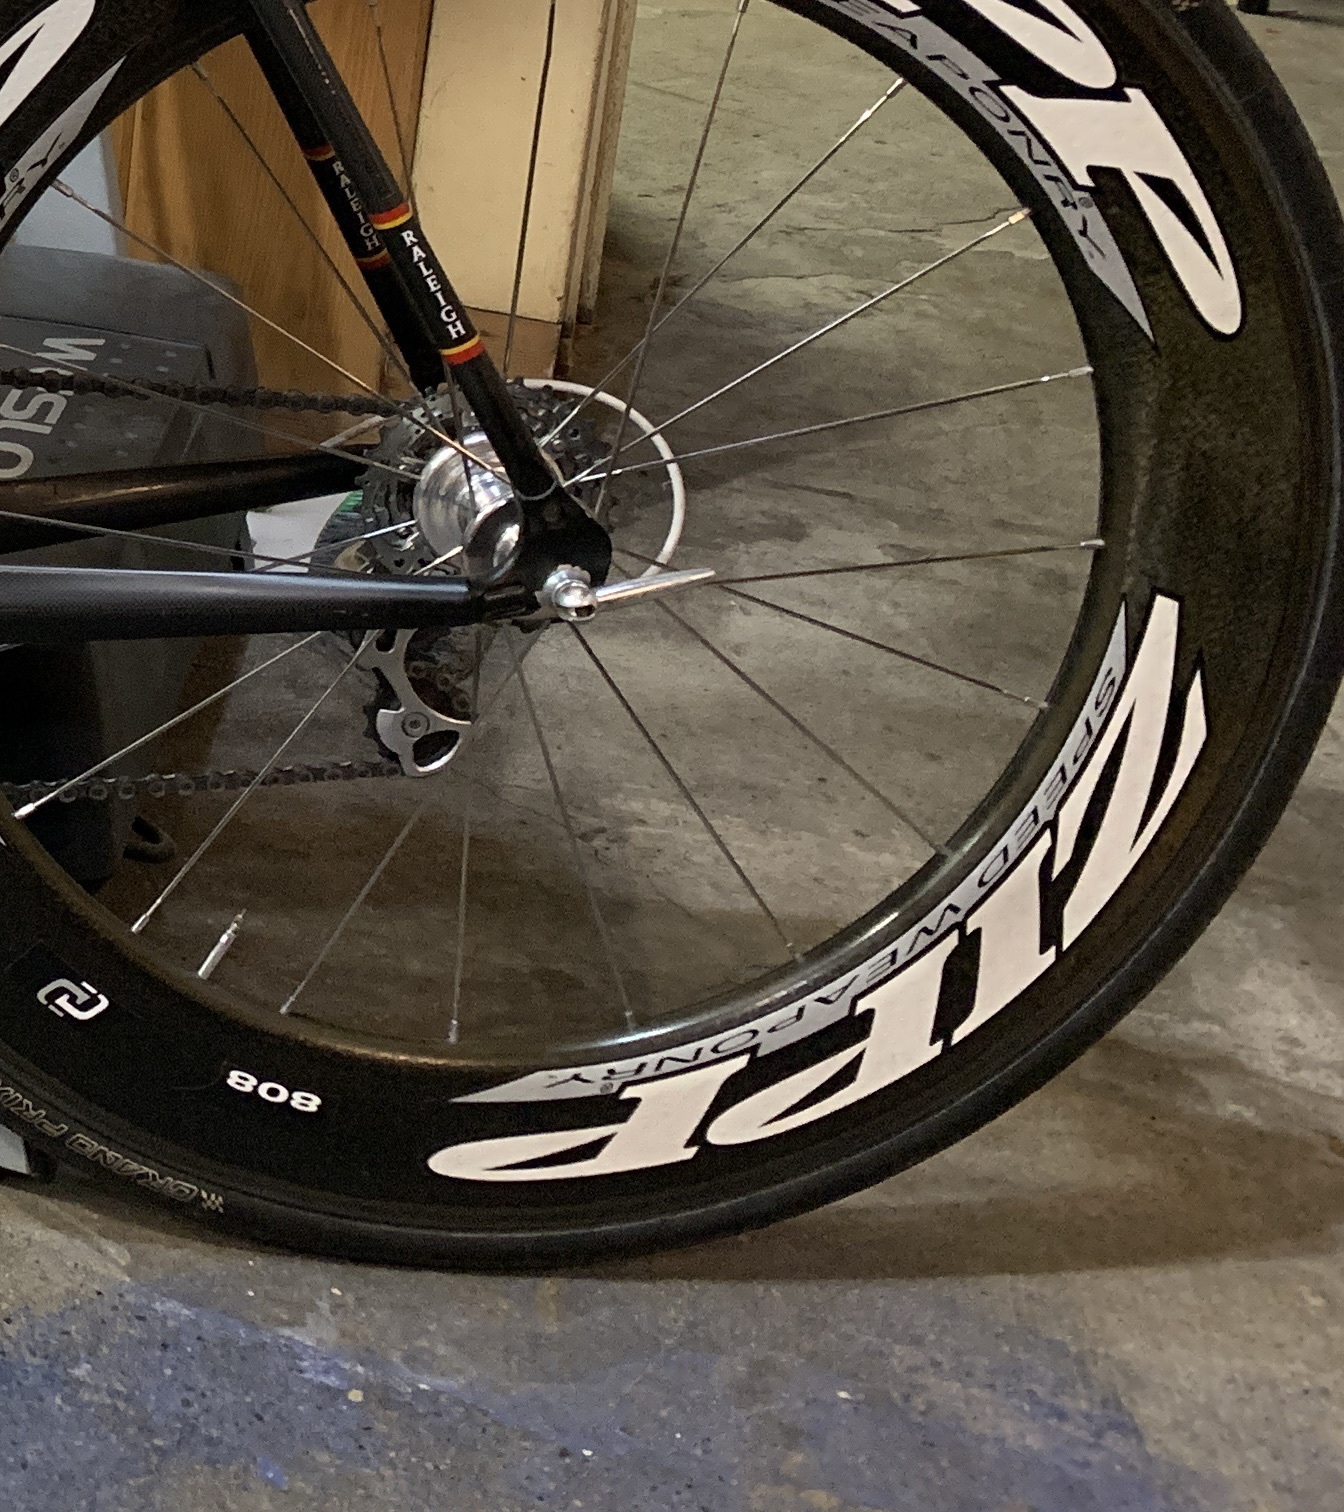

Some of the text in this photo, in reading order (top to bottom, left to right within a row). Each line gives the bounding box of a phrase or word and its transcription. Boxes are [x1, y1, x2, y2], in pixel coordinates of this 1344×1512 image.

[332, 161, 381, 251] RALEIGH
[400, 229, 467, 340] RALEIGH
[976, 666, 1120, 888] SPEED
[425, 591, 1211, 1184] ZIPP
[226, 1068, 323, 1114] 808
[65, 1132, 200, 1202] GRAND
